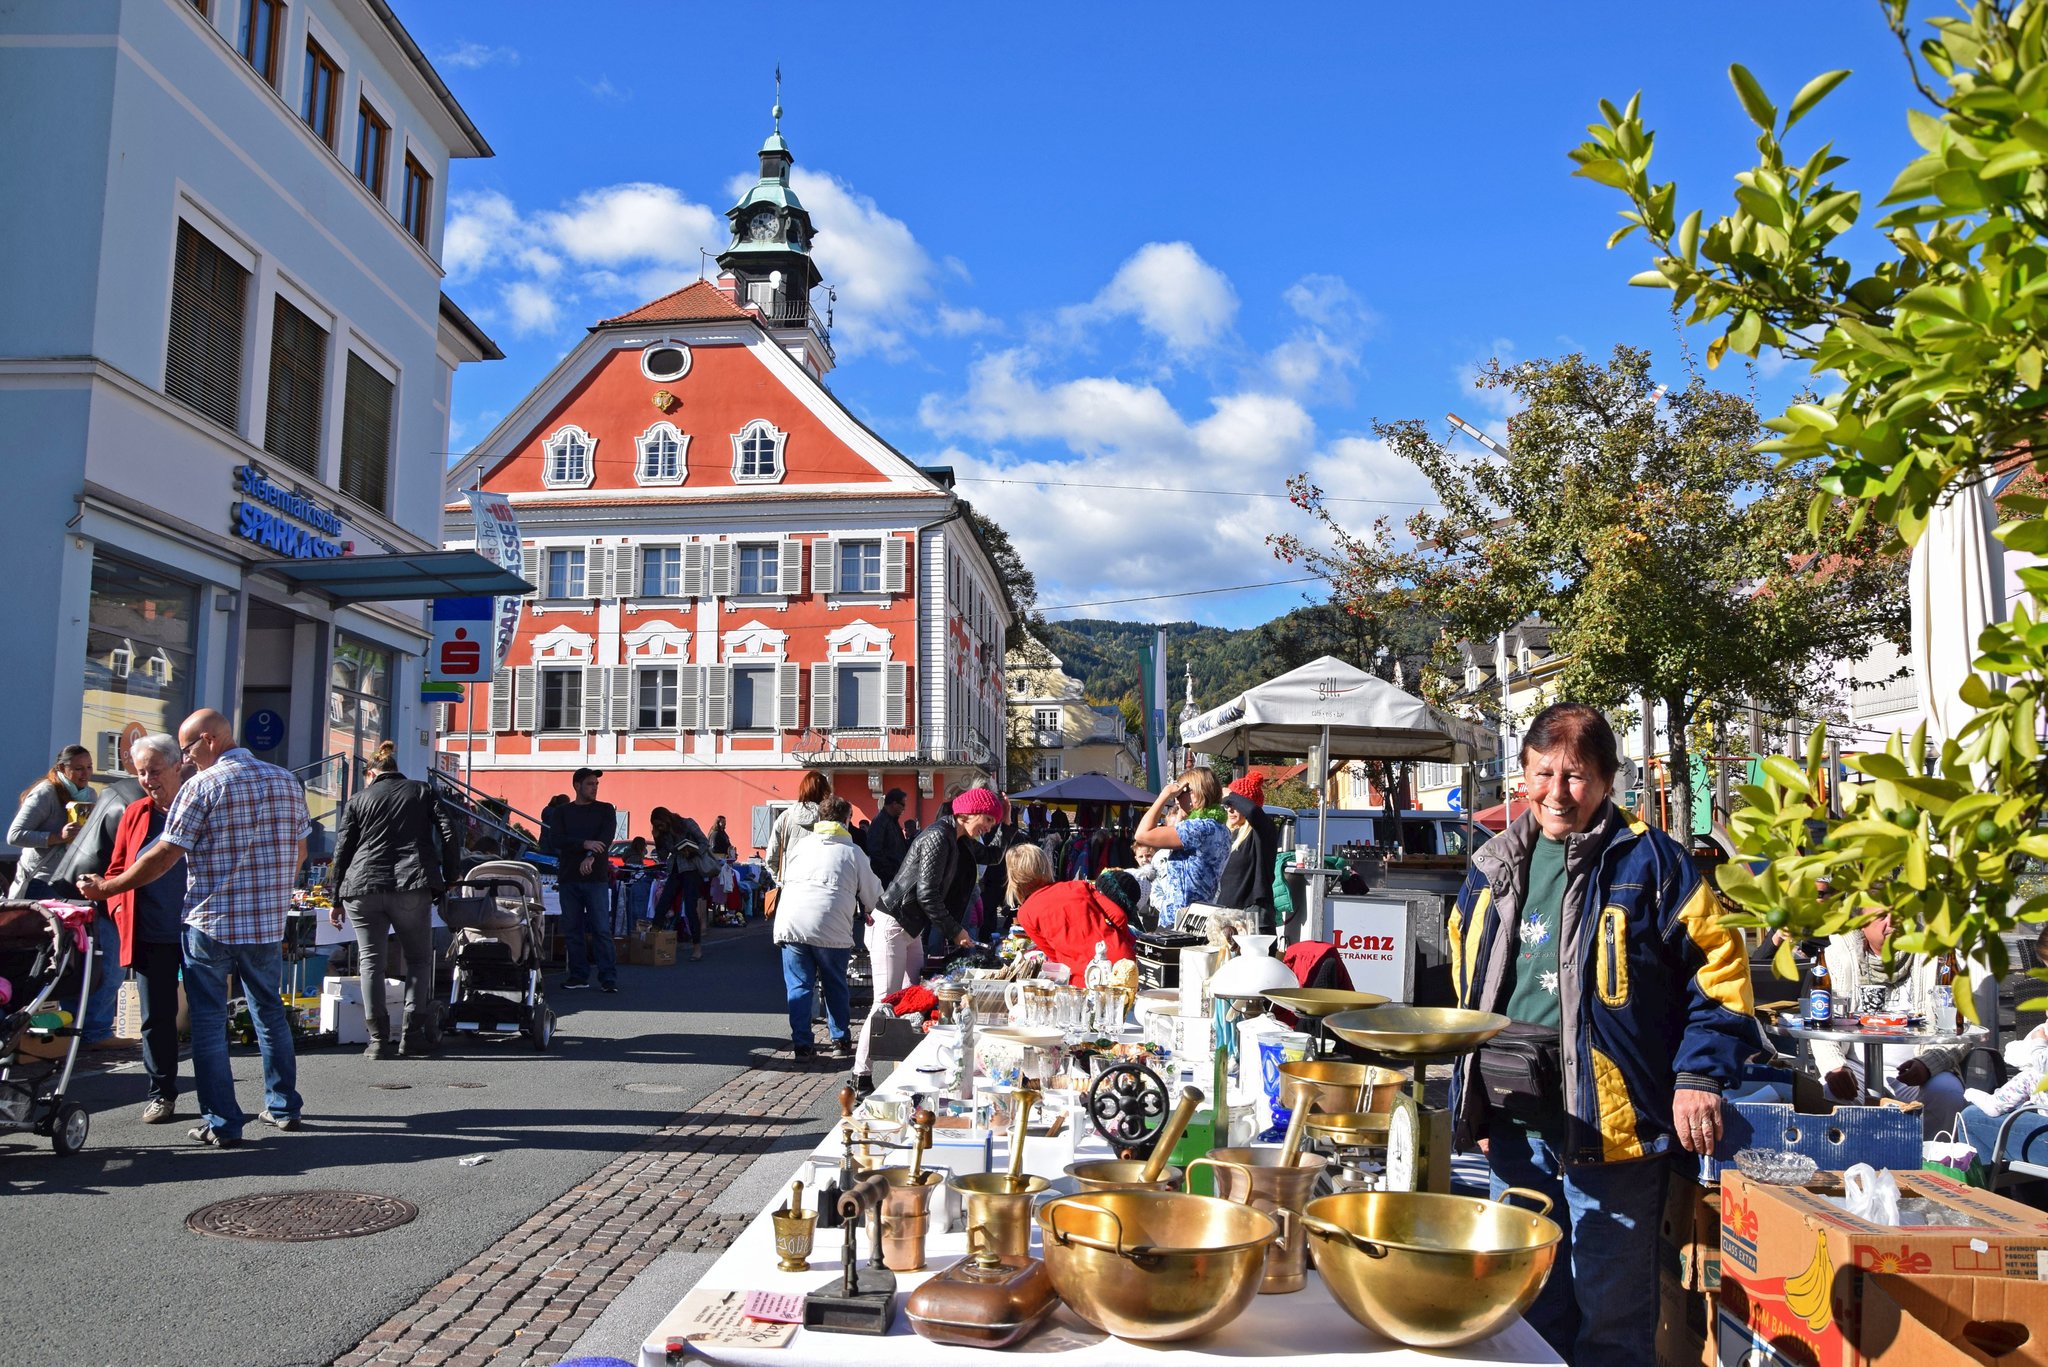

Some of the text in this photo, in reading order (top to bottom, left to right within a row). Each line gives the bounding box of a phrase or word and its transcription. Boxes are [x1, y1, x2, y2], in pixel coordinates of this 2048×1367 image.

[1332, 929, 1395, 951] Lenz
[1722, 1186, 1758, 1242] Dole
[1722, 1239, 1756, 1270] CLASS EXTRA
[1853, 1244, 1933, 1275] Dole
